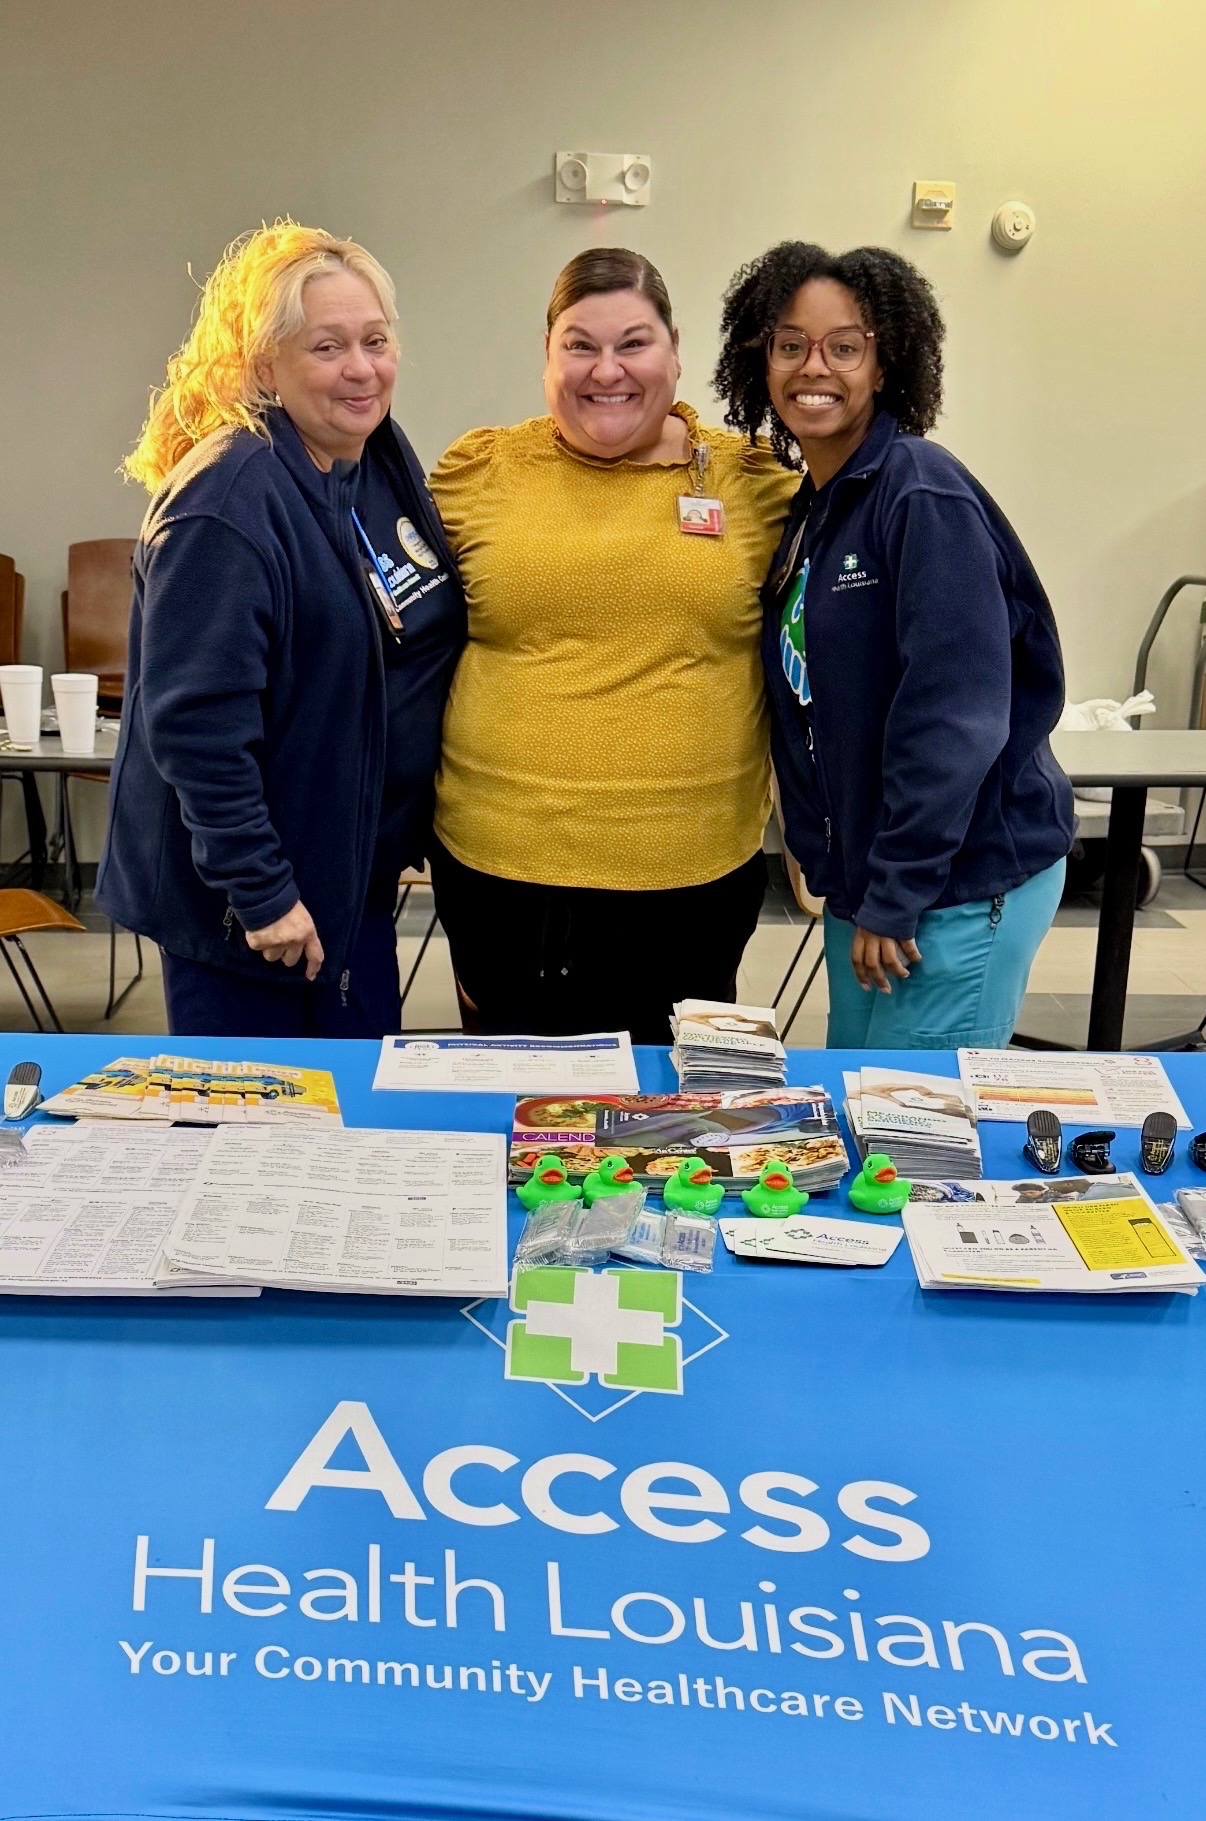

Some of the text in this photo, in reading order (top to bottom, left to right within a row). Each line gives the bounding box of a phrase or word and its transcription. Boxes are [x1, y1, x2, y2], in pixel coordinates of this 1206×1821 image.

[838, 571, 867, 582] Access
[816, 1233, 869, 1245] Access
[264, 1400, 931, 1562] Access
[132, 1535, 1088, 1684] Health Louisiana
[118, 1640, 1119, 1748] Your Community Healthcare Network
